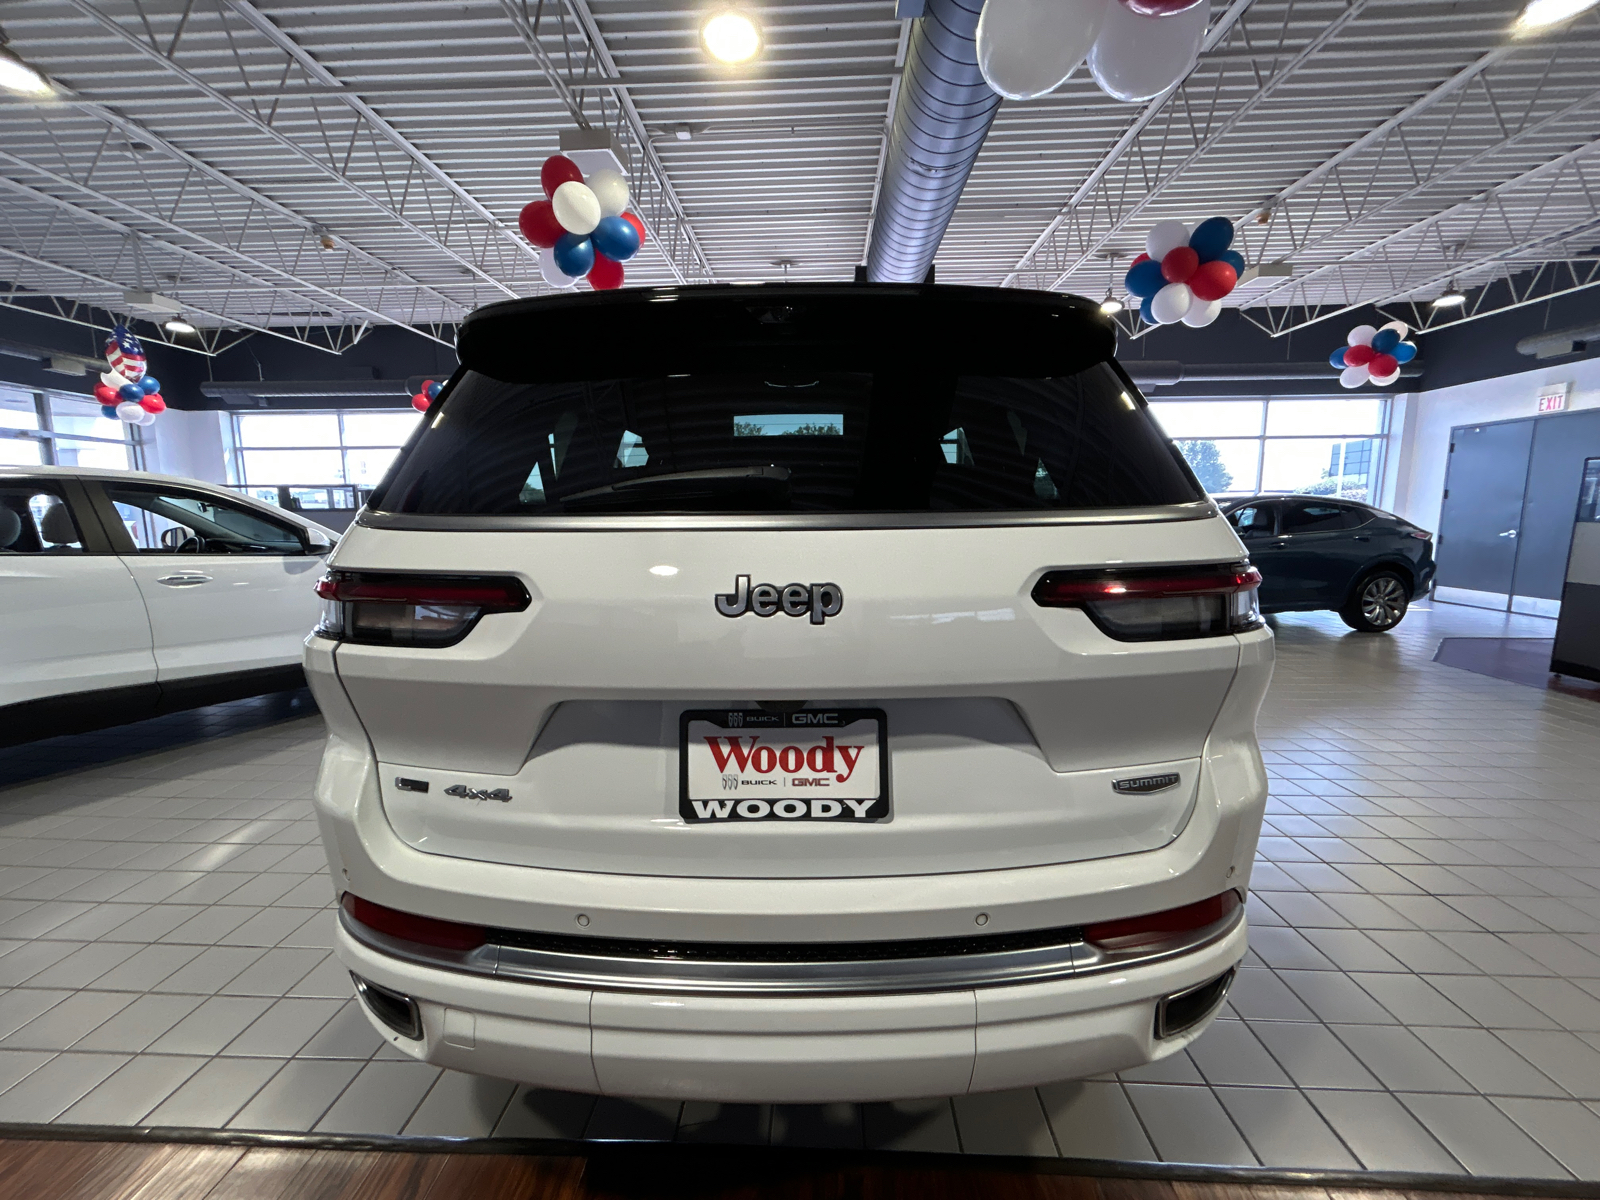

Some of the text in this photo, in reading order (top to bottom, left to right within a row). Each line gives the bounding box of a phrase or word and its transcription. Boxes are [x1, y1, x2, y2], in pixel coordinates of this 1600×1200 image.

[1538, 395, 1564, 412] EXIT
[715, 574, 843, 625] Jeep
[791, 713, 839, 724] GMC
[703, 735, 865, 783] Woody
[791, 777, 830, 787] GMC
[1119, 775, 1177, 788] SUMMIT
[444, 784, 513, 802] 4x4
[691, 799, 877, 819] WOODY
